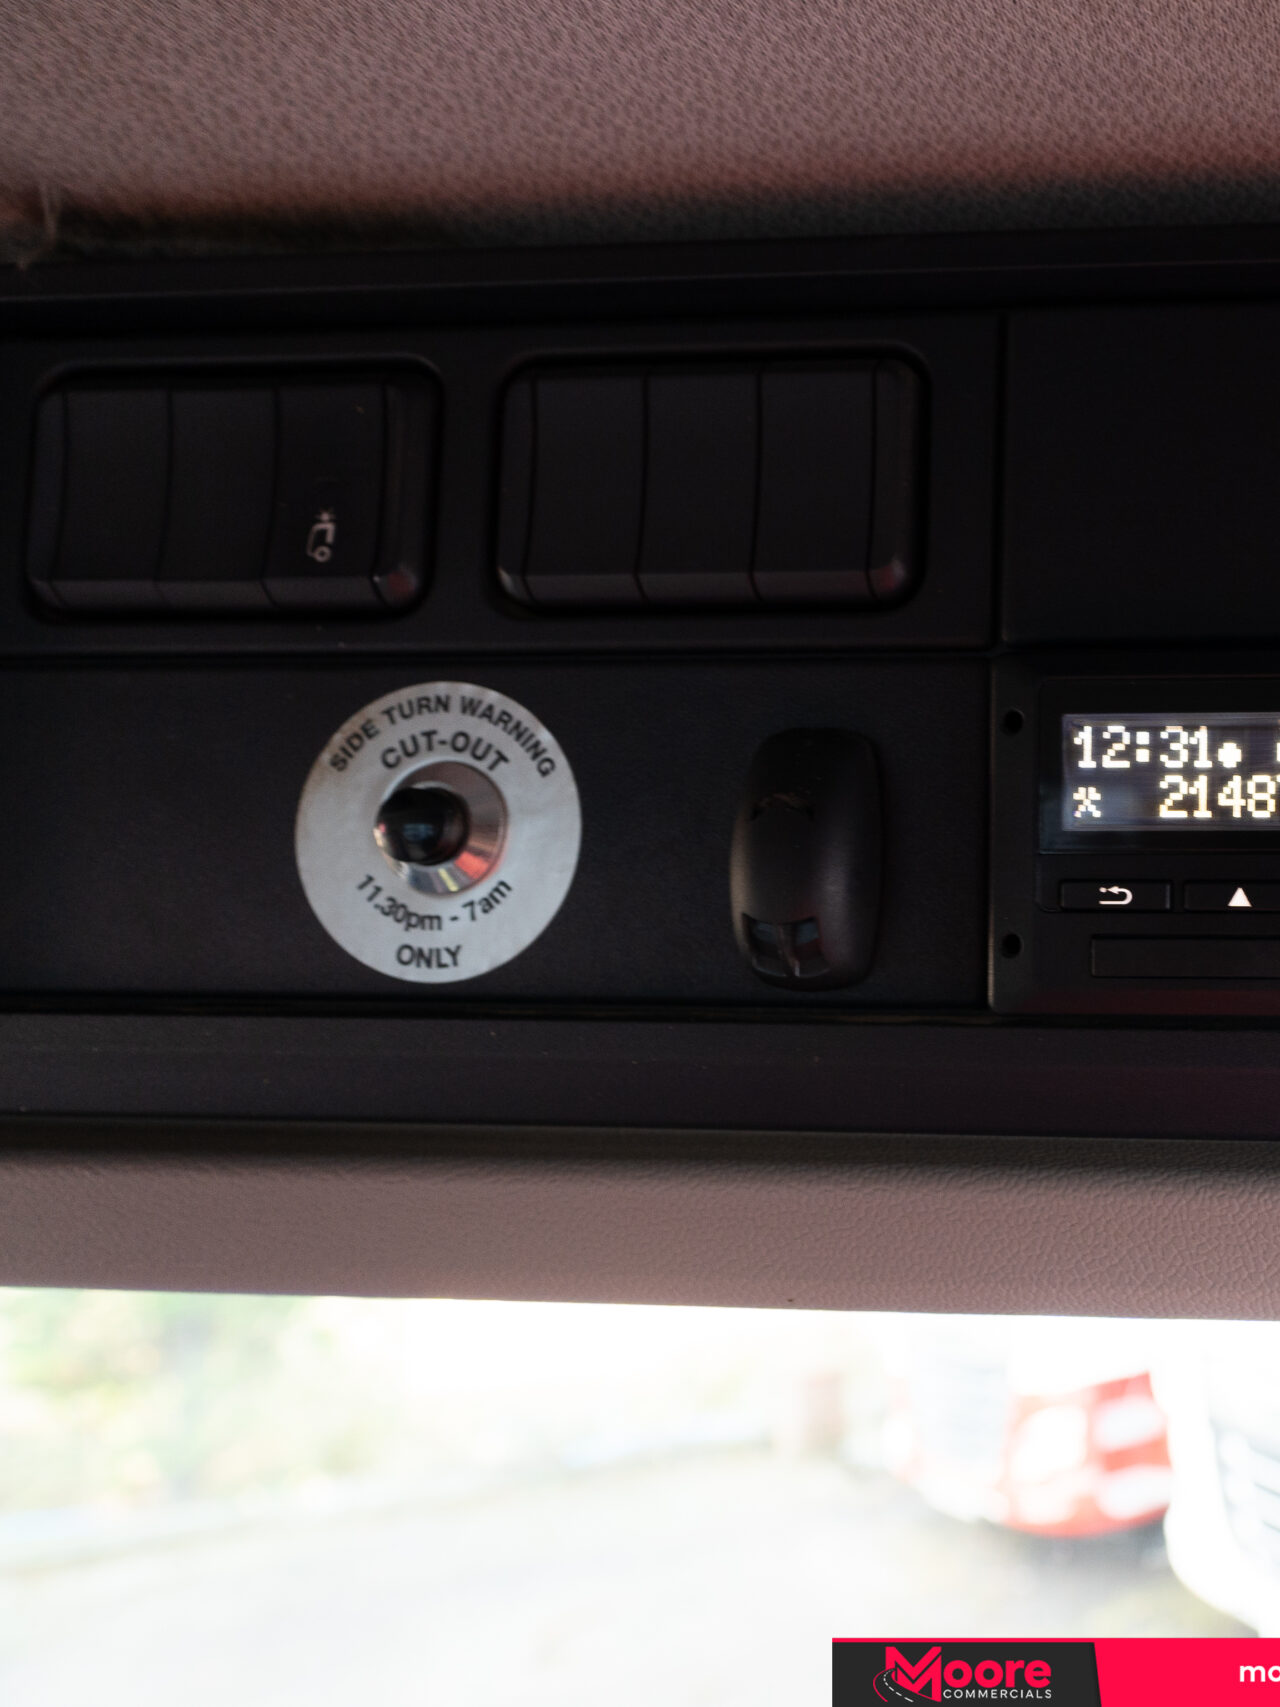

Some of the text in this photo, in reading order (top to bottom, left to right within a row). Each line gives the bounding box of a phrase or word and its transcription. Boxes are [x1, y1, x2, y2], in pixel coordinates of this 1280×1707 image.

[330, 695, 556, 778] SIDE TURN WARNING
[381, 730, 509, 772] CUT-OUT
[1073, 725, 1213, 769] 12:31
[357, 875, 442, 932] 11.30pm
[462, 880, 513, 921] 7am
[396, 944, 462, 969] ONLY
